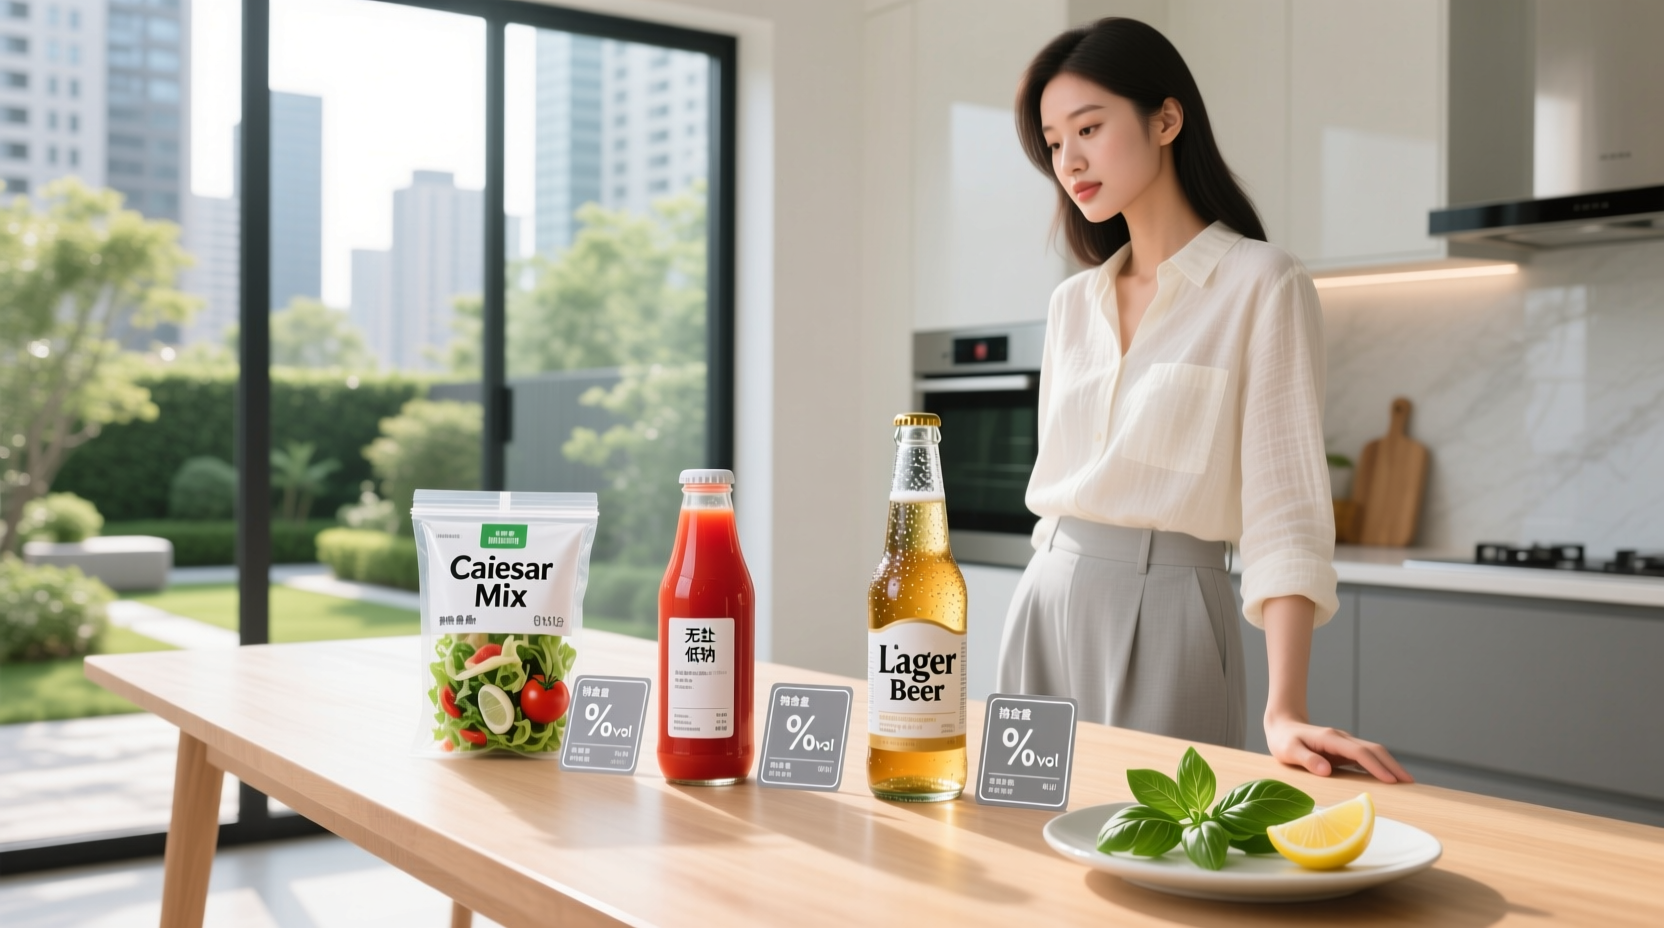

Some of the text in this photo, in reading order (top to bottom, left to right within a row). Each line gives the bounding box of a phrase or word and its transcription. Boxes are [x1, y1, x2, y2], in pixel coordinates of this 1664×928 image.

[450, 555, 553, 580] Caiesar
[475, 583, 527, 608] Mix
[879, 644, 956, 683] Lager
[890, 679, 945, 701] Beer
